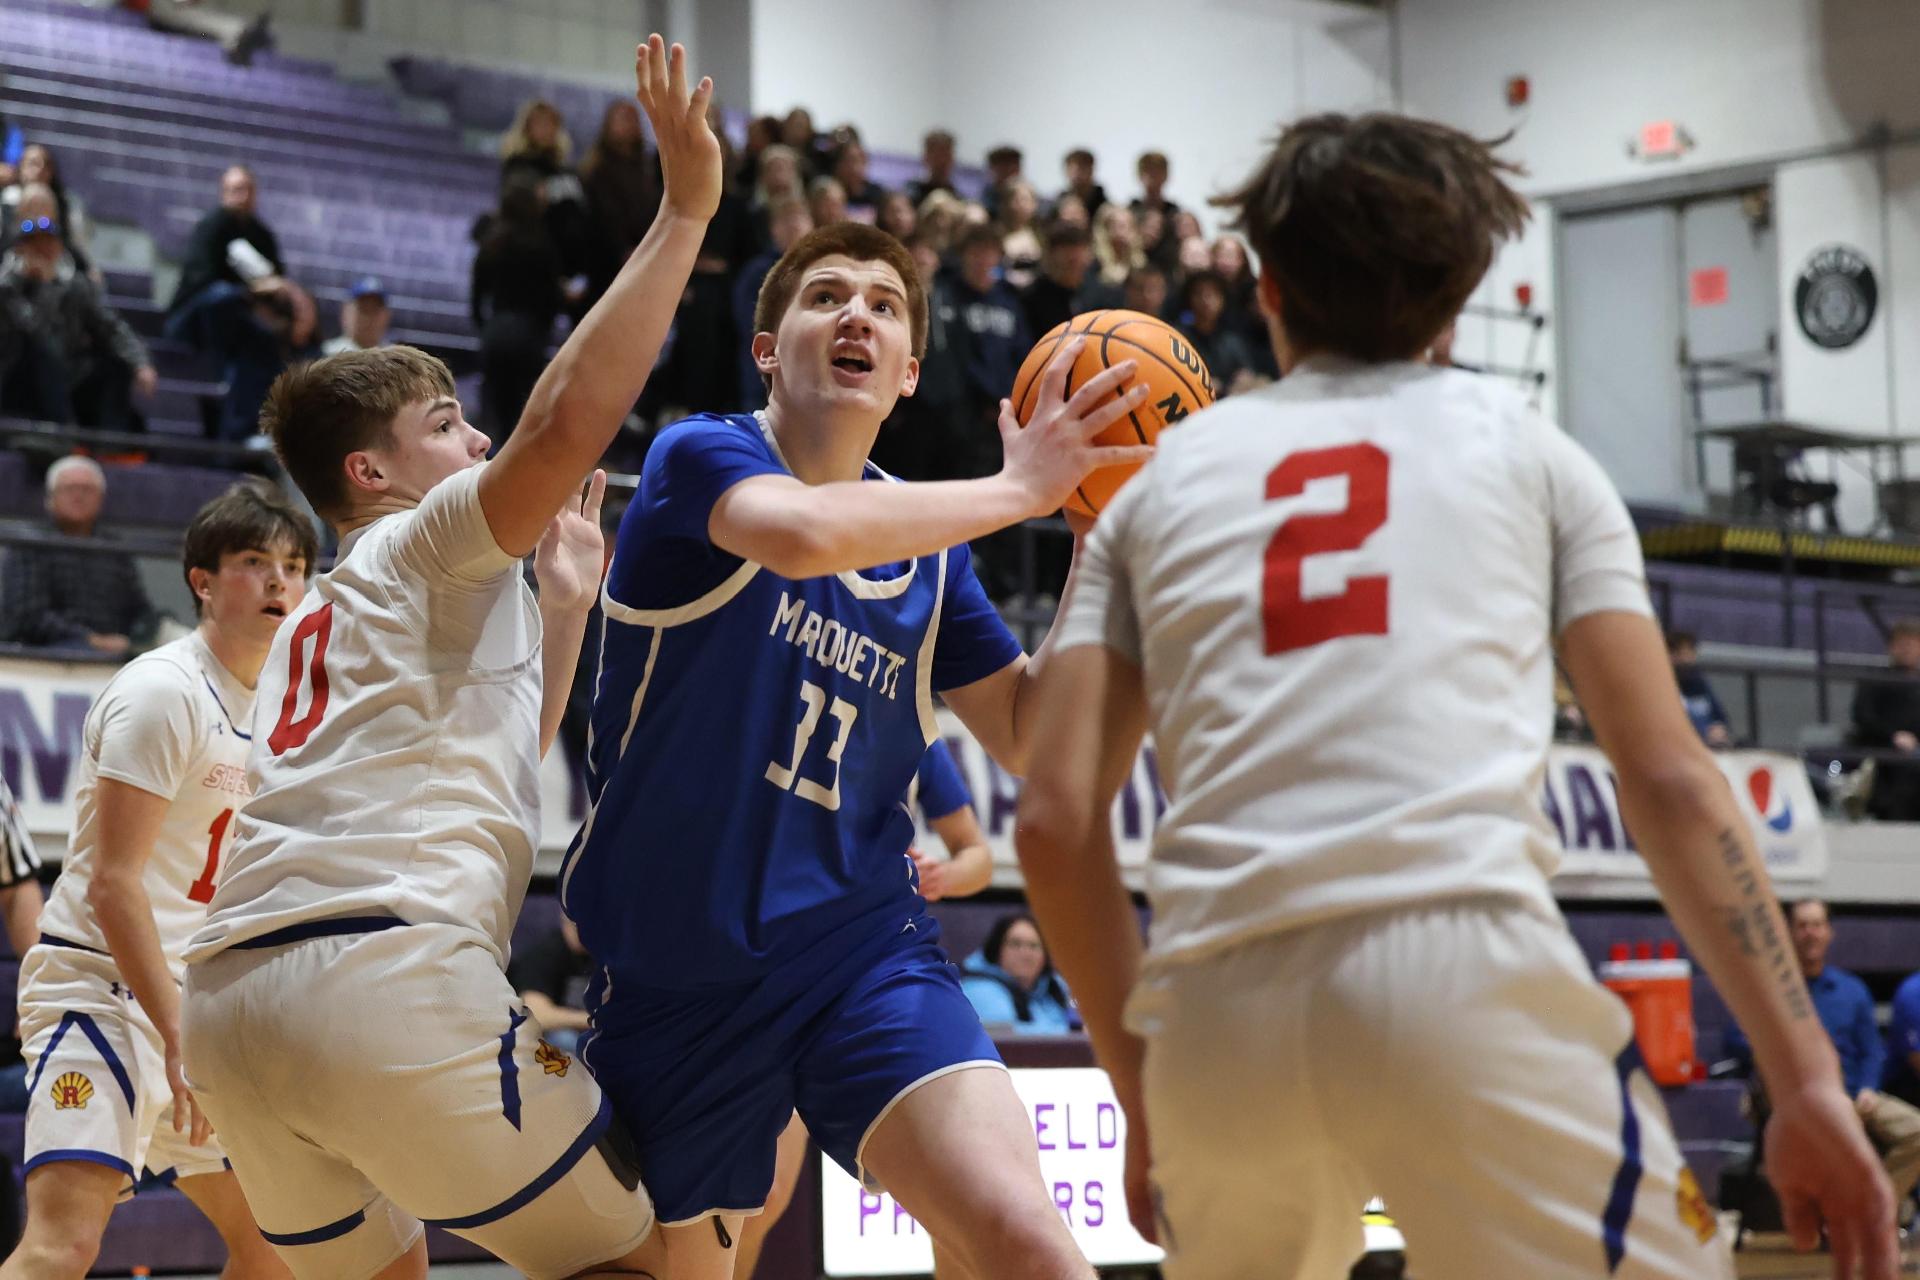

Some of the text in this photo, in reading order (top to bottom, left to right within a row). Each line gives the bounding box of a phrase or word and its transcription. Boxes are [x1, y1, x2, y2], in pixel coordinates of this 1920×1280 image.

[1261, 440, 1390, 658] 2
[267, 600, 334, 757] 0
[202, 763, 253, 797] SHE
[764, 679, 858, 812] 33
[187, 807, 236, 905] 1
[1035, 1102, 1117, 1151] ELD
